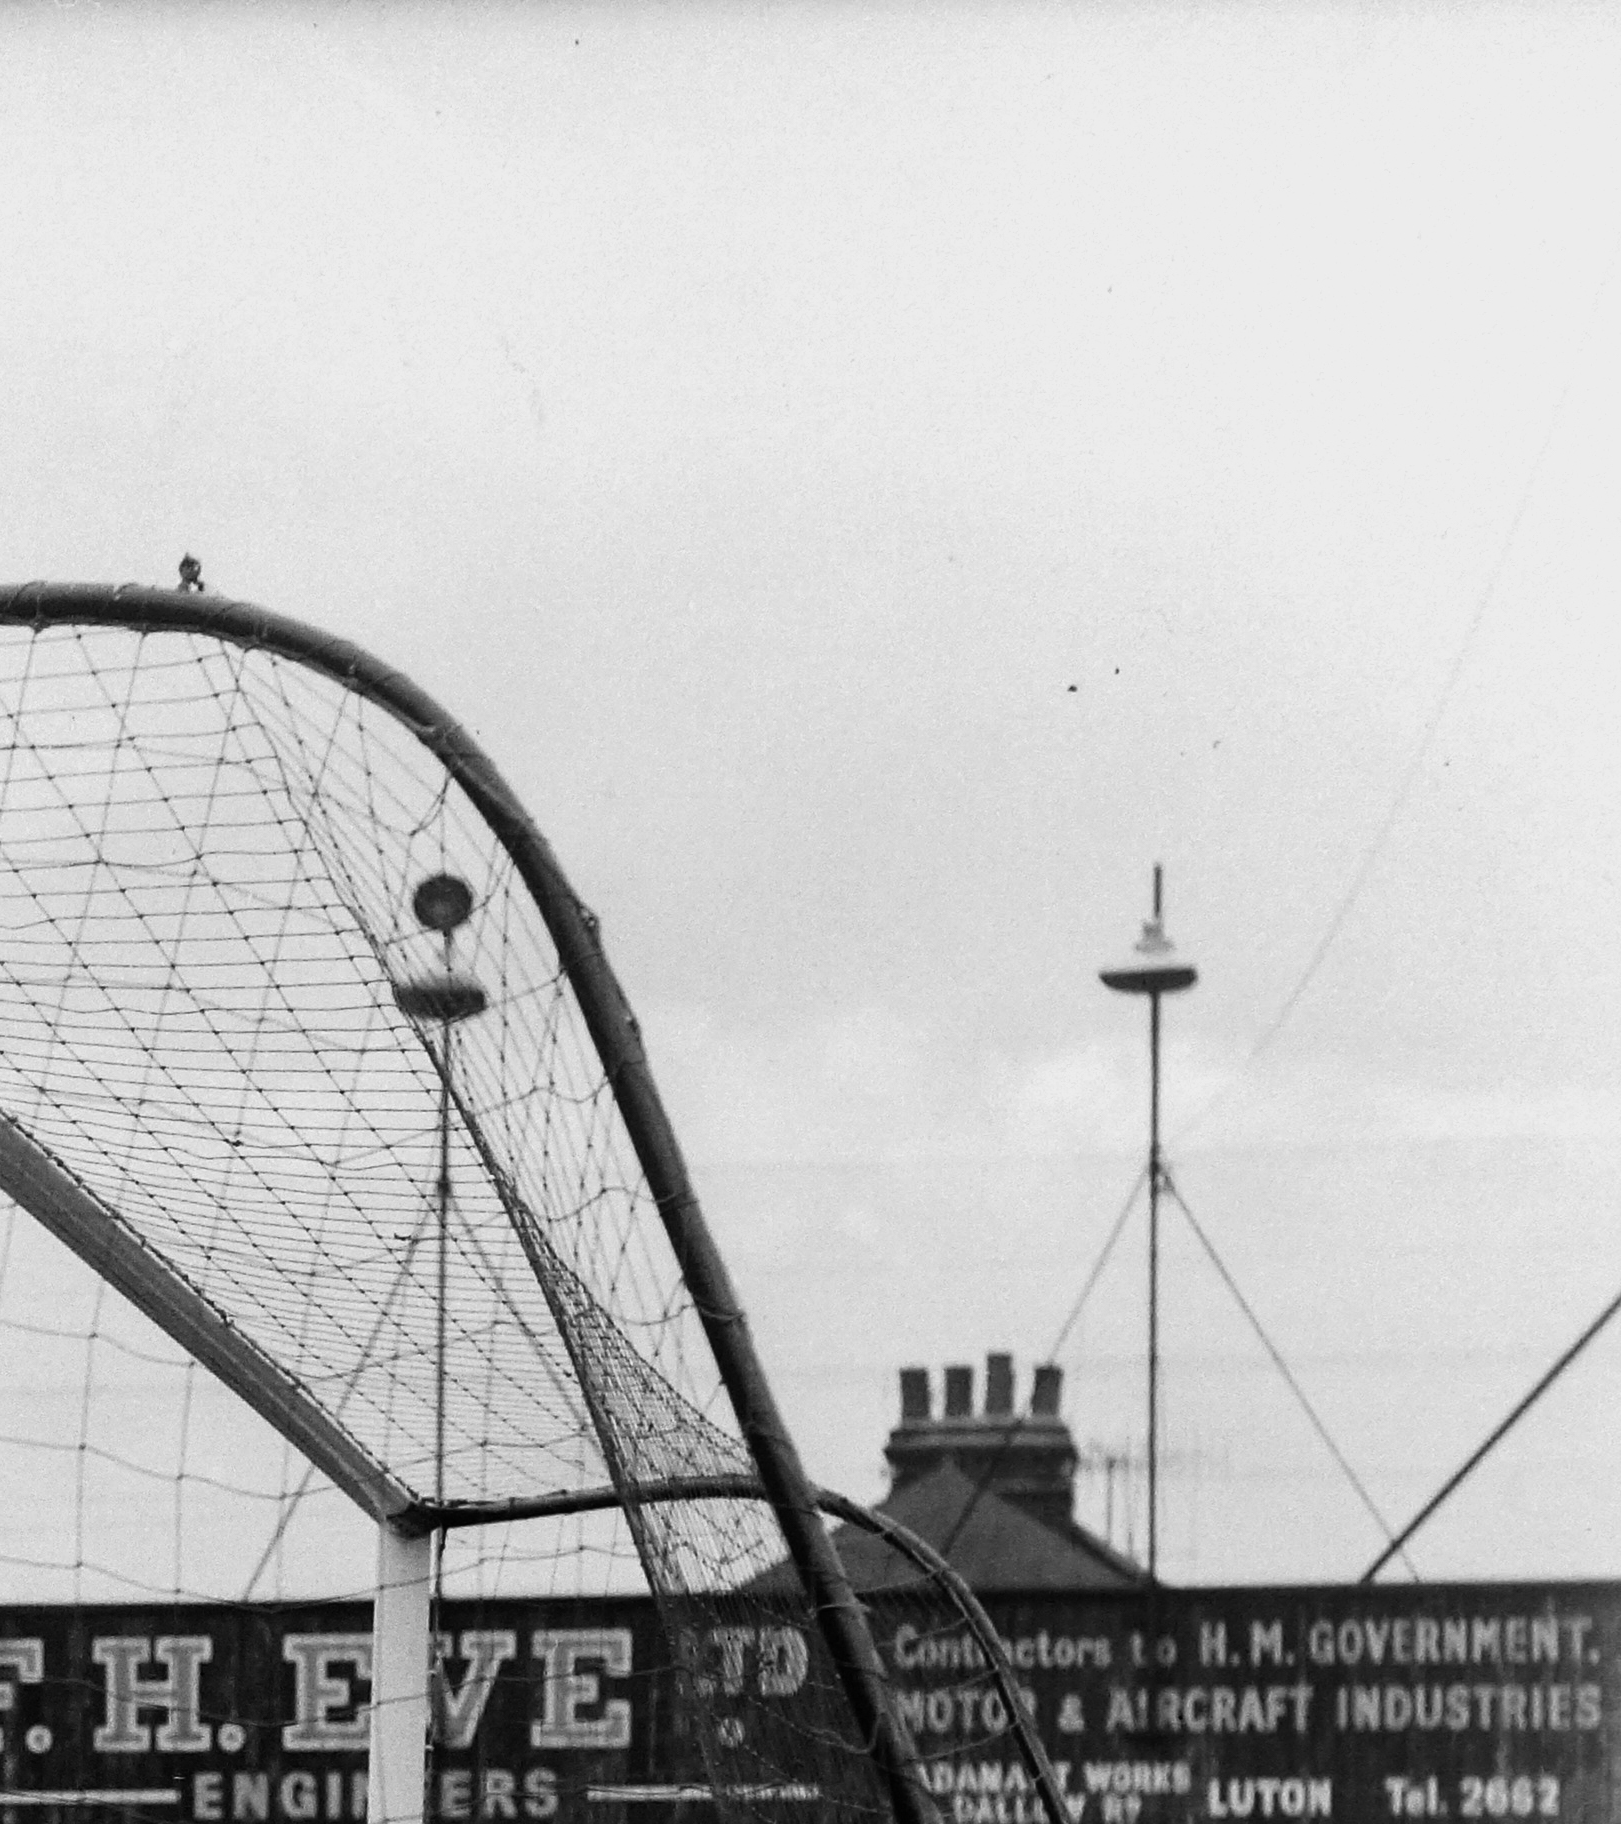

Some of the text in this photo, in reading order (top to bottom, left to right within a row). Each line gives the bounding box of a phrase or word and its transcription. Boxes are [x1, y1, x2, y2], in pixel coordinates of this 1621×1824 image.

[1129, 1630, 1178, 1670] to
[281, 1628, 633, 1750] EVE
[1058, 1693, 1087, 1733] &
[1106, 1685, 1314, 1735] AIRCRAFT
[1336, 1682, 1604, 1733] INDUSTRIES
[193, 1764, 559, 1821] ENGIERS
[1206, 1774, 1335, 1819] LUTON
